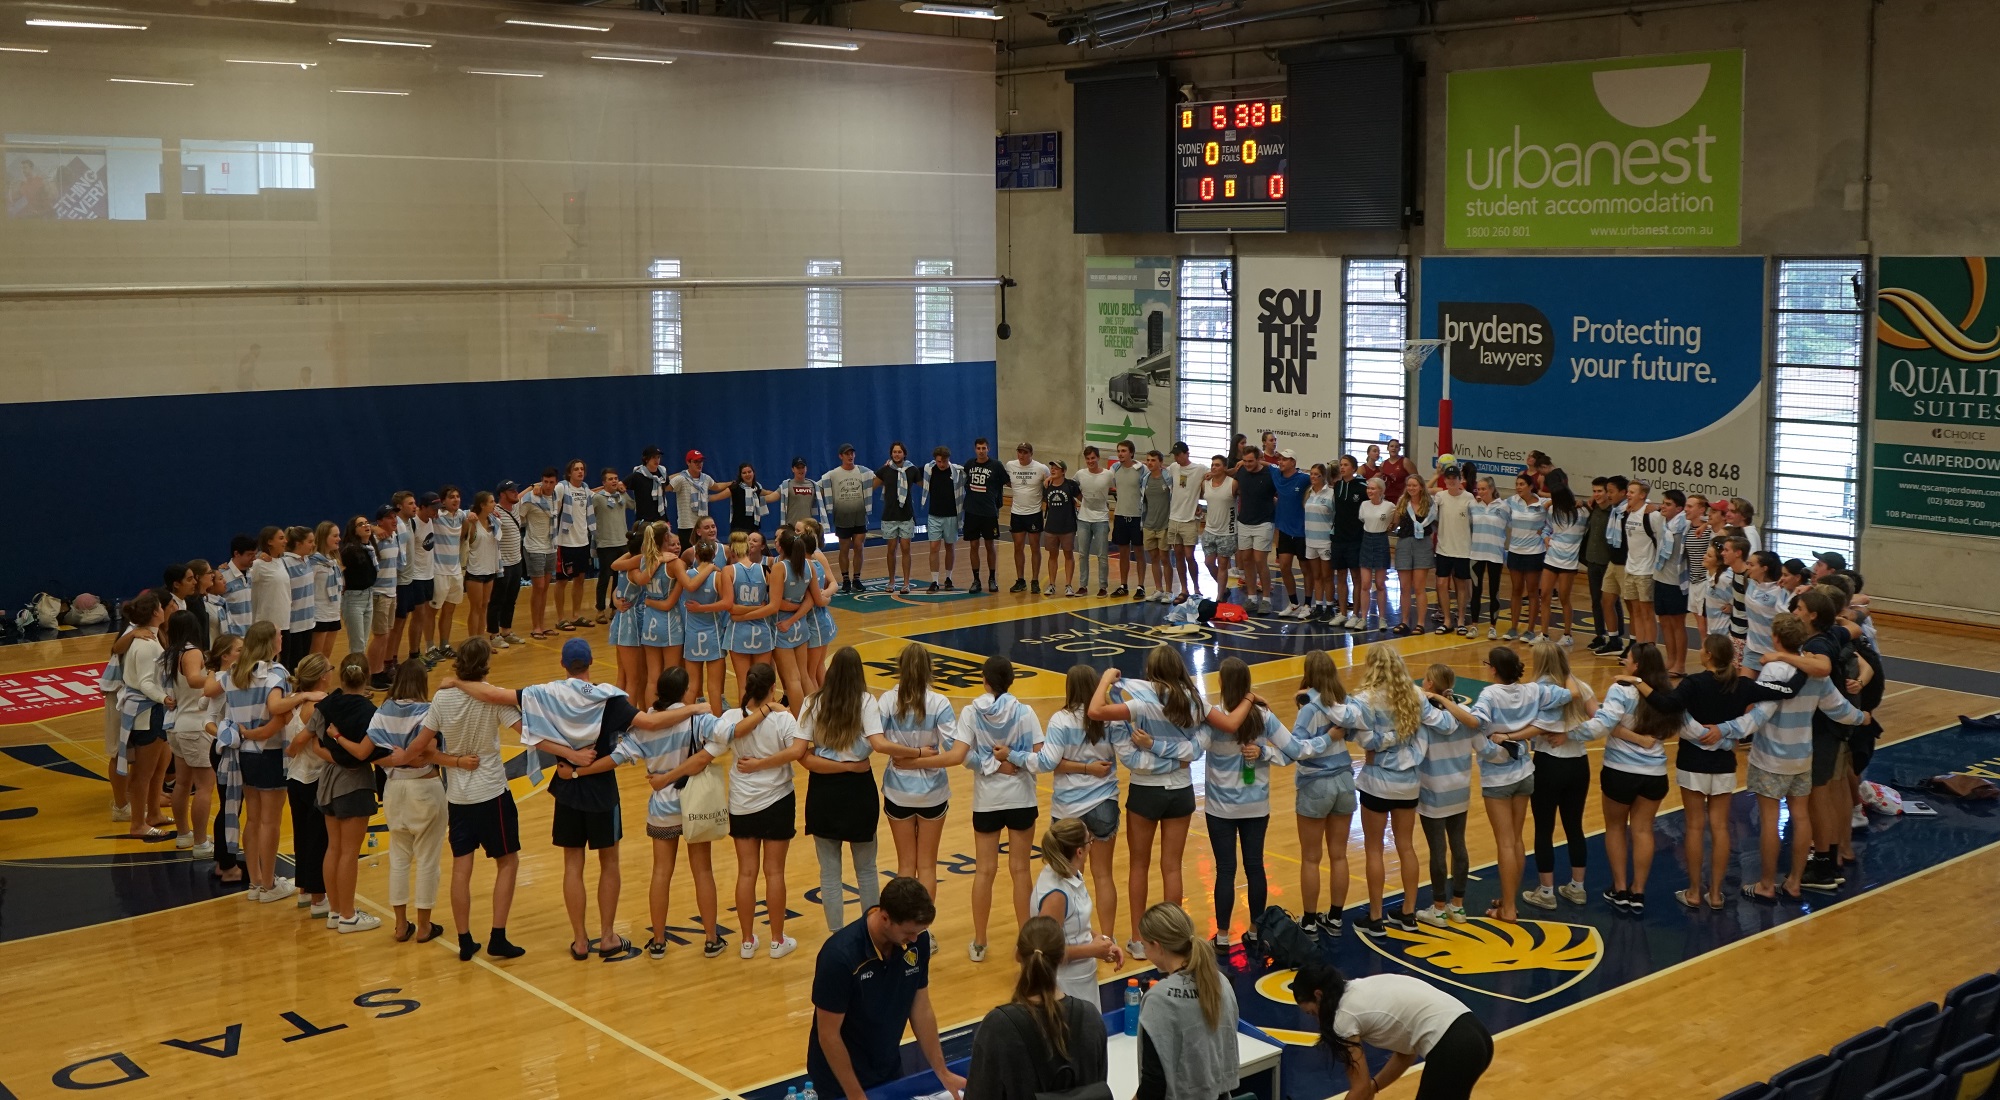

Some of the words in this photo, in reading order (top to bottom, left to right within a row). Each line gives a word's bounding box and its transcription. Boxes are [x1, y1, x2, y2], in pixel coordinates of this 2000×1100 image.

[1182, 110, 1192, 128] 0
[1270, 104, 1282, 122] 0
[1177, 142, 1205, 155] SYDNEY
[1204, 141, 1219, 165] 0
[1221, 145, 1240, 153] TEAM
[1242, 140, 1257, 164] 0
[1257, 143, 1285, 156] AWAY
[1182, 156, 1198, 168] UNI
[1221, 154, 1241, 162] FOULS
[1466, 124, 1717, 190] urbanest
[1200, 177, 1214, 201] 0
[1225, 179, 1235, 198] 0
[1268, 174, 1284, 199] 0
[1466, 194, 1538, 218] student
[1544, 190, 1714, 215] accommodation
[1466, 226, 1490, 238] 1800
[1492, 226, 1511, 238] 260
[1512, 225, 1531, 237] 801
[1590, 224, 1714, 237] www.urbanest.com.au
[1099, 303, 1120, 316] VOLVO
[1121, 303, 1143, 316] BUSES
[1257, 288, 1321, 325] SOU
[1105, 317, 1114, 325] ONE
[1114, 317, 1125, 326] STEP
[1099, 326, 1117, 334] FURTHER
[1118, 326, 1139, 335] TOWARDS
[1445, 313, 1543, 350] brydens
[1572, 316, 1702, 354] Protecting
[1104, 335, 1134, 349] GREENER
[1114, 349, 1127, 357] CITIES
[1480, 345, 1543, 371] lawyers
[1263, 357, 1307, 395] RN
[1570, 356, 1625, 384] your
[1631, 353, 1717, 384] future.
[1245, 405, 1266, 413] brand
[1276, 407, 1301, 417] digital
[1311, 410, 1331, 419] print
[1913, 400, 2000, 420] SUITES
[1943, 429, 1986, 440] CHOICE
[1453, 443, 1474, 458] Win,
[1477, 445, 1493, 459] No
[1500, 465, 1518, 474] FREE
[1630, 456, 1667, 474] 1800
[1672, 459, 1704, 478] 848
[1708, 462, 1740, 481] 848
[1903, 452, 2000, 471] CAMPERDOW
[971, 473, 986, 484] 158
[1927, 497, 1943, 506] (02)
[1944, 498, 1964, 507] 9028
[1965, 500, 1986, 509] 7900
[1901, 511, 1947, 523] Parramatta
[1948, 516, 1971, 525] Road,
[740, 584, 760, 602] GA
[688, 808, 729, 821] BERKELOUW
